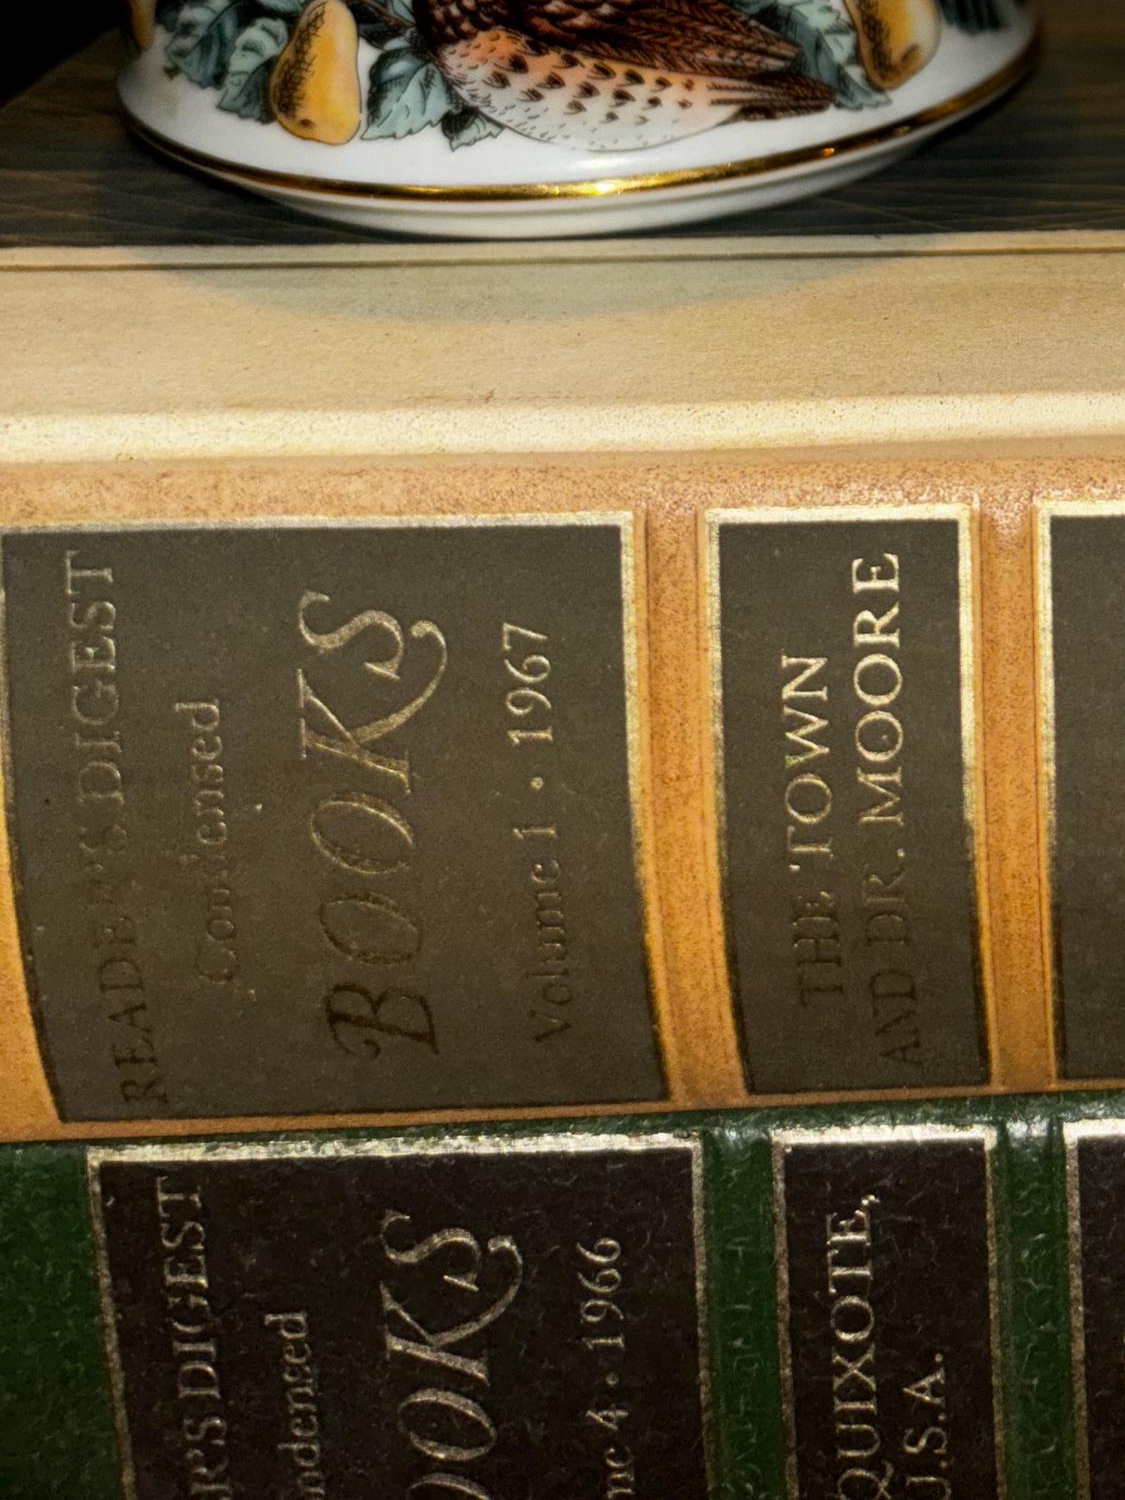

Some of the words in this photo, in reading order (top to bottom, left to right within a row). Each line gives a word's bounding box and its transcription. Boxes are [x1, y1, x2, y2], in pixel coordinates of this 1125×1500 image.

[64, 549, 125, 808] DIGEST
[503, 622, 556, 745] 1967
[851, 551, 904, 824] MOORE
[297, 588, 449, 1061] BOOKS
[511, 821, 560, 840] 1
[780, 653, 835, 876] TOWN
[173, 699, 238, 984] Condensed
[857, 846, 911, 944] DR.
[522, 859, 572, 1043] Volume
[790, 890, 845, 1003] THE
[868, 968, 923, 1067] AND
[155, 1175, 222, 1401] DIGEST
[575, 1236, 626, 1350] 1966
[584, 1403, 630, 1430] 4
